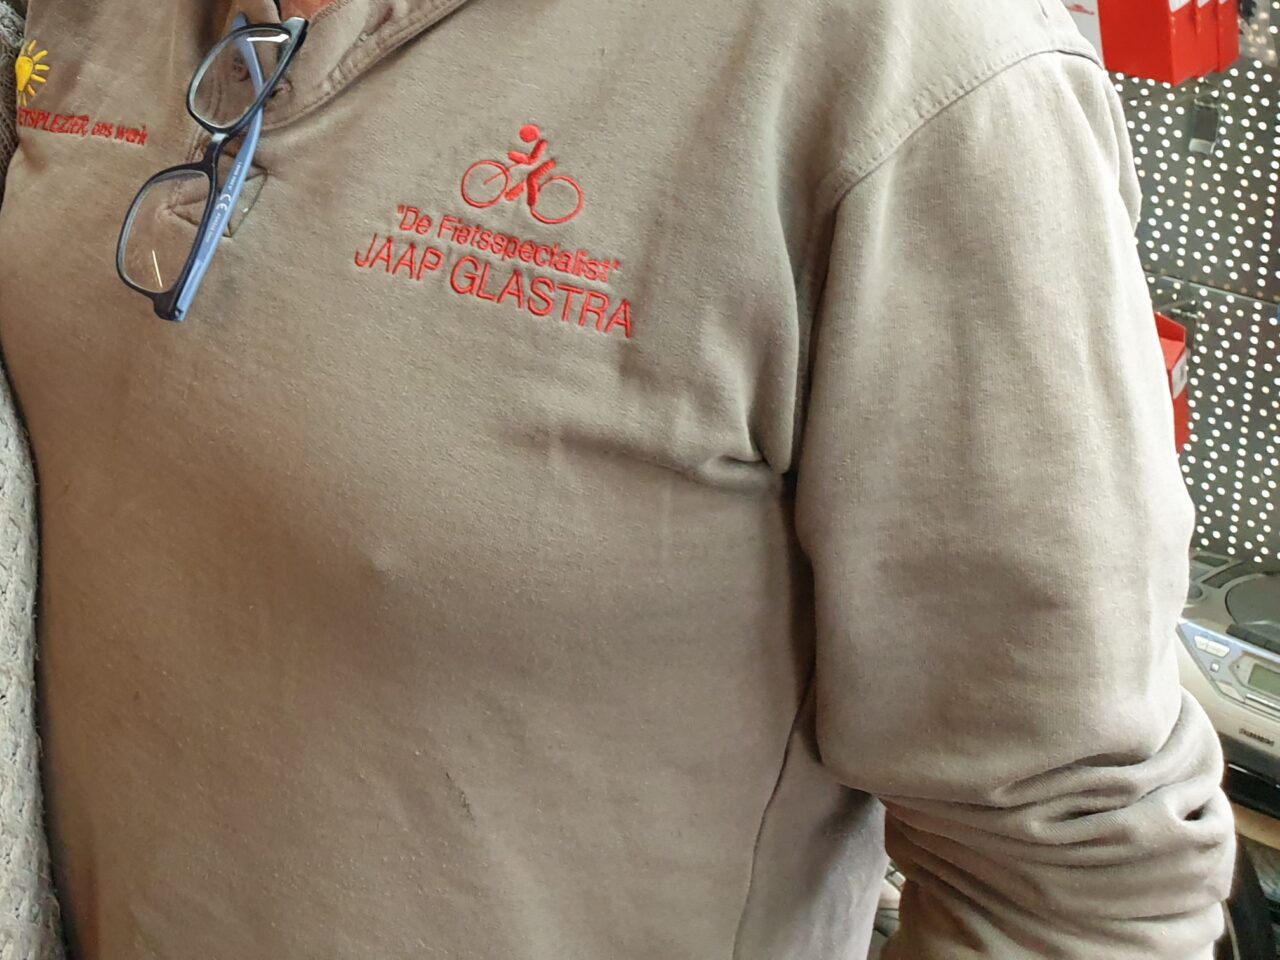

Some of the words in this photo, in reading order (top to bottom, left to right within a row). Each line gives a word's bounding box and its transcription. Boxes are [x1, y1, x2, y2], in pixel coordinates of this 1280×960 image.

[354, 233, 444, 282] JAAP
[450, 256, 633, 339] GLASTRA
[397, 204, 433, 235] "De
[437, 215, 621, 284] Fietsspecialist"
